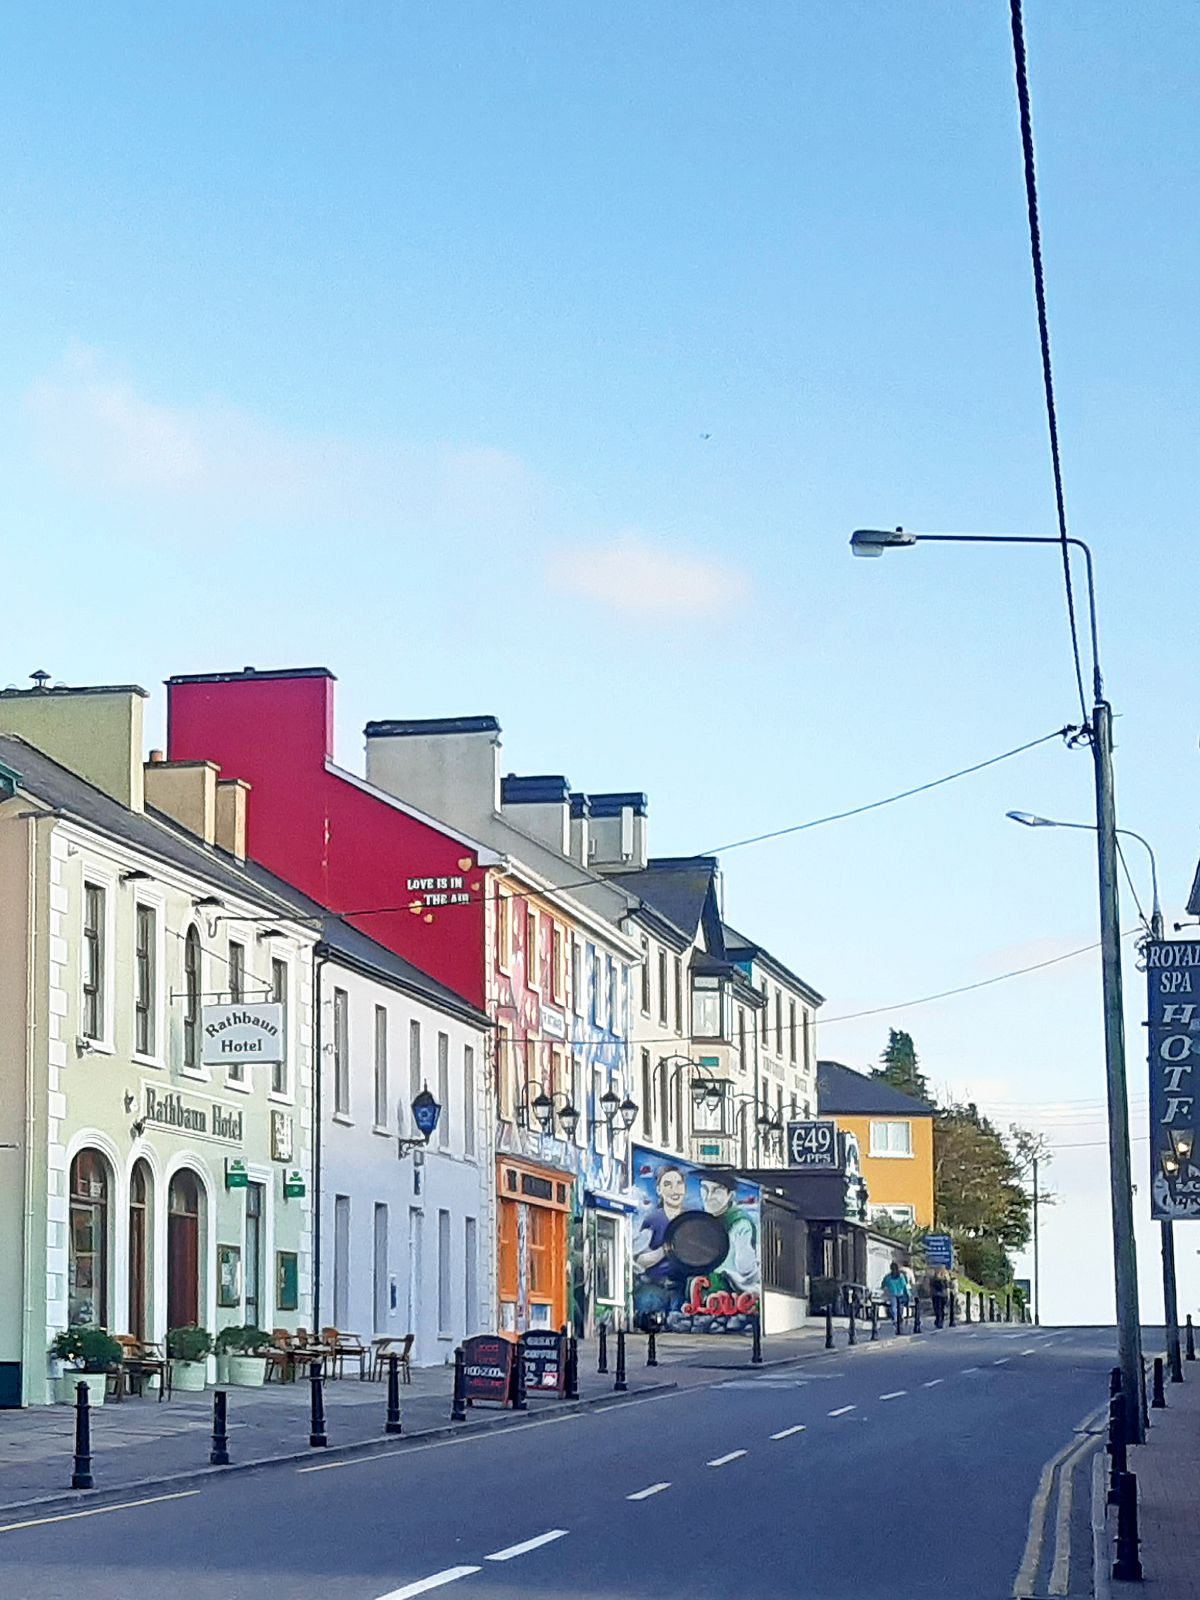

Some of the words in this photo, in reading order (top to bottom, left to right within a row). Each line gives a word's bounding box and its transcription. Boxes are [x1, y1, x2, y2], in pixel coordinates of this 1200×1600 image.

[407, 878, 434, 890] LOVE
[437, 878, 447, 889] IS
[450, 877, 462, 889] IN
[423, 893, 447, 906] THE
[451, 893, 469, 905] AIR
[1160, 971, 1192, 993] SPA
[205, 1012, 279, 1038] Rathbaun
[221, 1039, 262, 1053] Hotel
[146, 1087, 207, 1133] Rathbaun
[211, 1104, 243, 1142] Hotel
[791, 1127, 831, 1162] €49
[807, 1153, 831, 1163] PPS
[681, 1275, 757, 1316] Love
